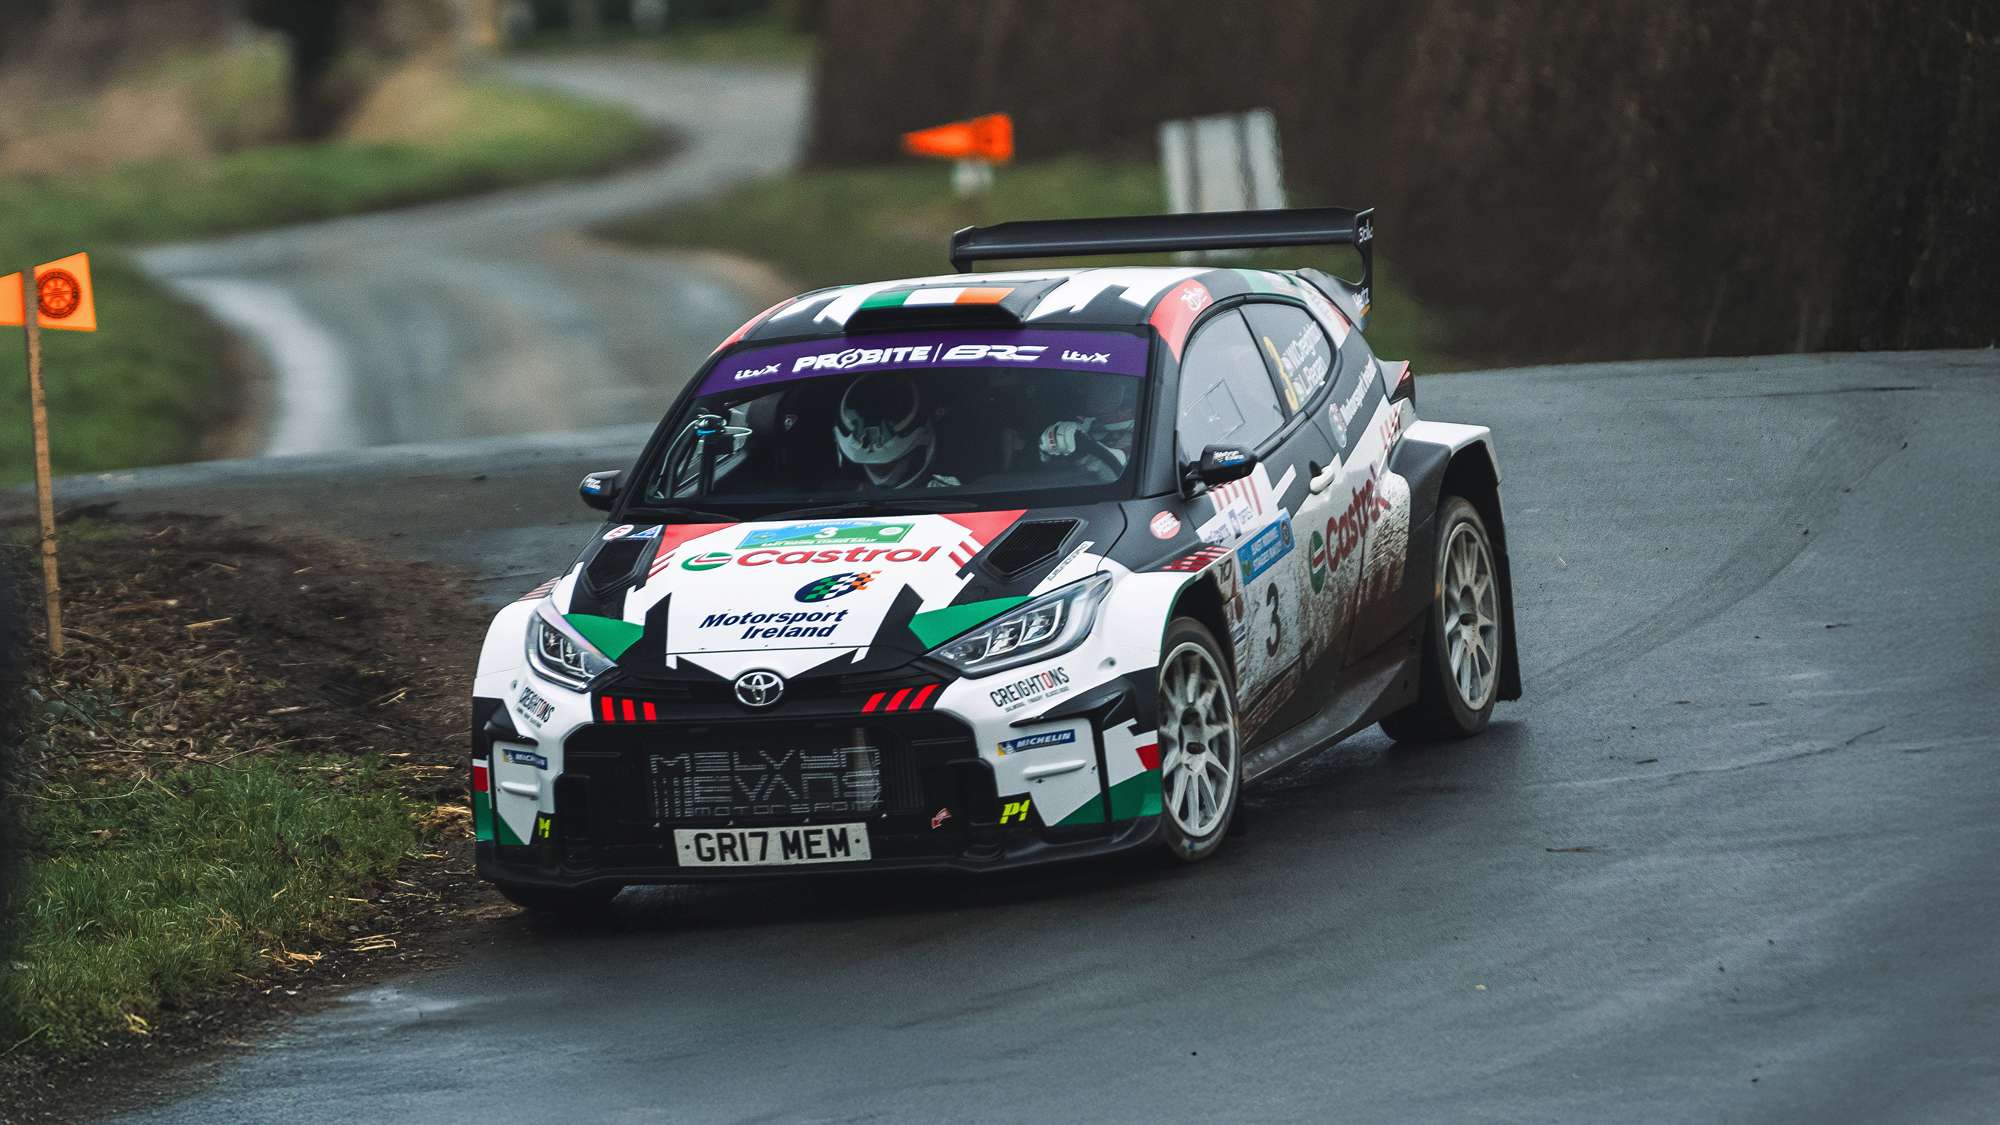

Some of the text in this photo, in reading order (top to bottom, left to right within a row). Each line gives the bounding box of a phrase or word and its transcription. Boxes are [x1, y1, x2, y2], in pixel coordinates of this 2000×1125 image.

[791, 345, 932, 374] PROBITE
[1061, 349, 1111, 365] itvX
[814, 527, 839, 539] 3
[736, 545, 943, 568] Castrol
[698, 608, 849, 629] Motorsport
[1265, 582, 1281, 658] 3
[740, 624, 838, 640] Ireland
[990, 666, 1070, 708] CREIGHTONS
[1016, 731, 1073, 749] MICHELIN
[694, 827, 851, 863] GR17 MEM
